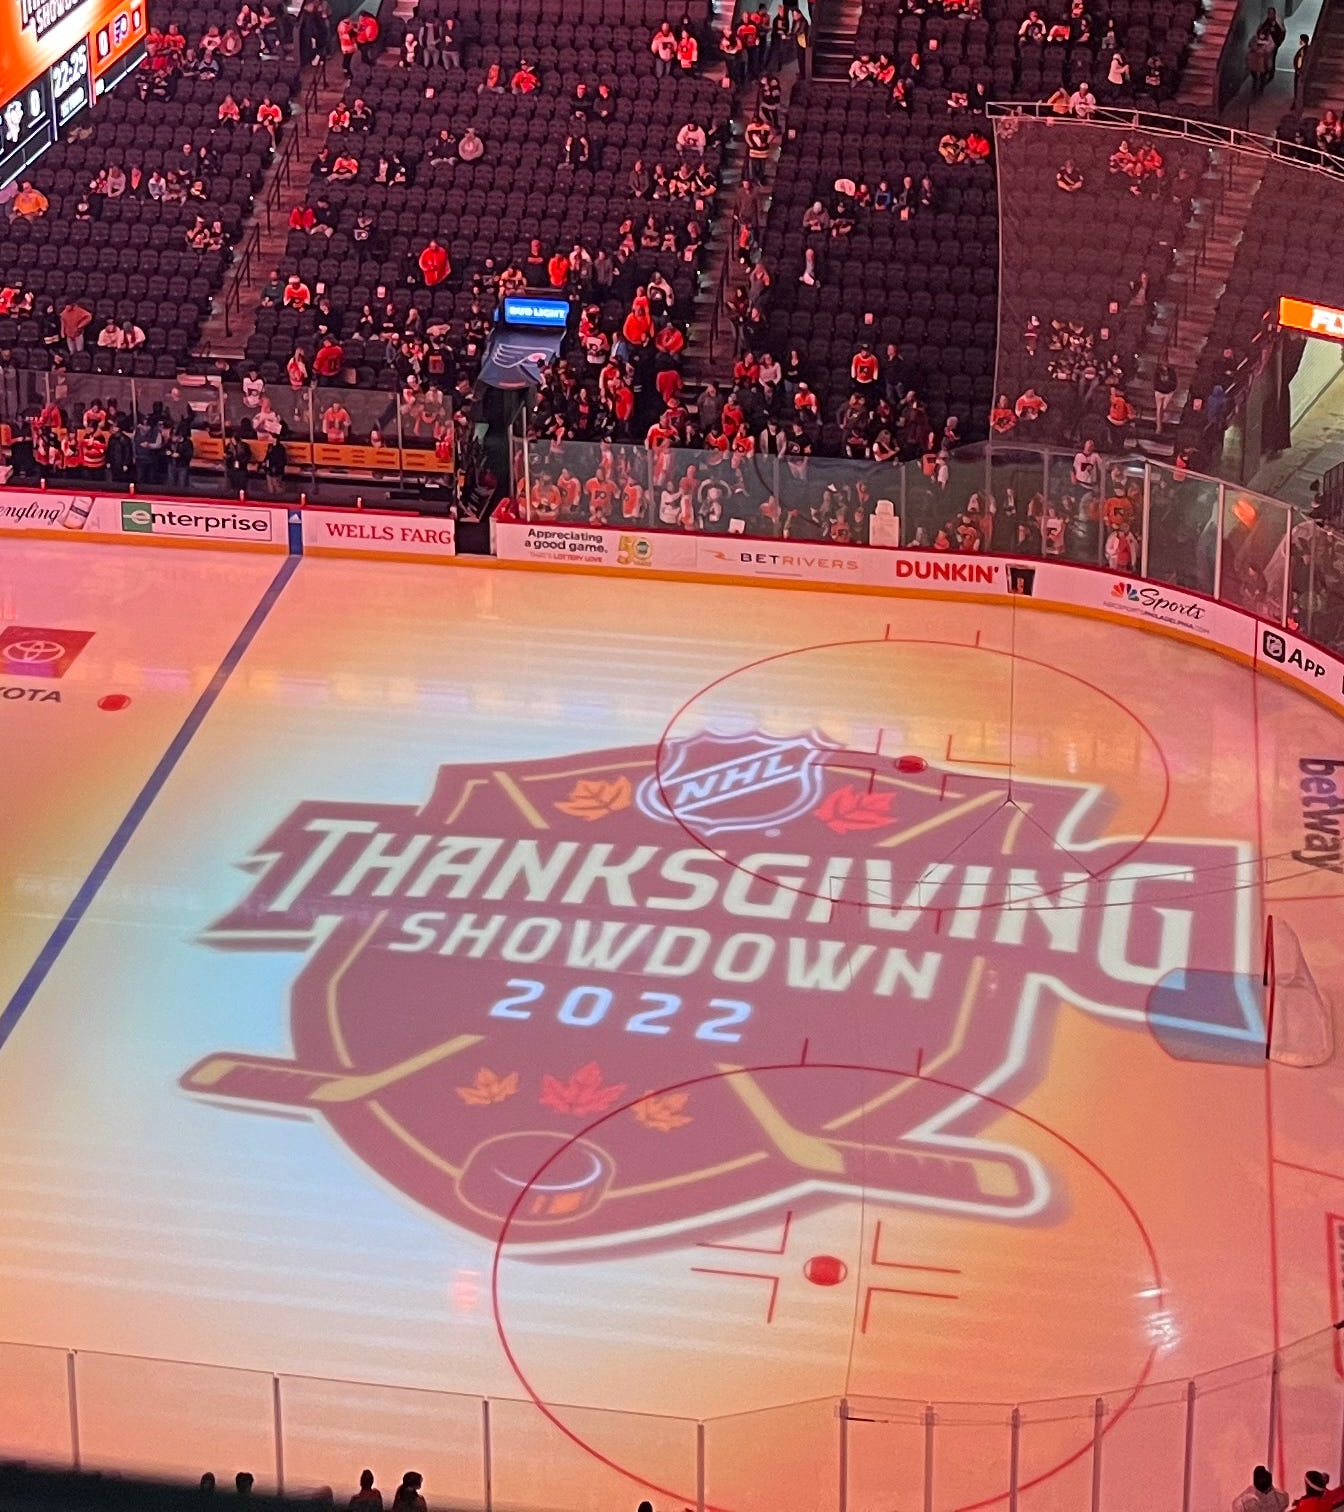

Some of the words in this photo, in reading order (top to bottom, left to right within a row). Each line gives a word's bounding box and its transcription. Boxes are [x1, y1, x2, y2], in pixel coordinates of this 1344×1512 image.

[130, 507, 270, 535] enterprise
[324, 522, 396, 543] WELLS
[400, 527, 456, 546] FARG
[527, 528, 603, 544] Appreciating
[533, 540, 566, 552] good
[569, 541, 609, 554] game.
[740, 552, 860, 571] BETRIVERS
[895, 559, 1000, 585] DUNKIN'
[1139, 587, 1206, 621] Sports
[1288, 648, 1327, 680] App
[676, 754, 796, 808] NHL
[265, 819, 1201, 986] THANKSGIVING
[387, 909, 943, 1002] SHOWDOWN
[489, 979, 755, 1045] 2022
